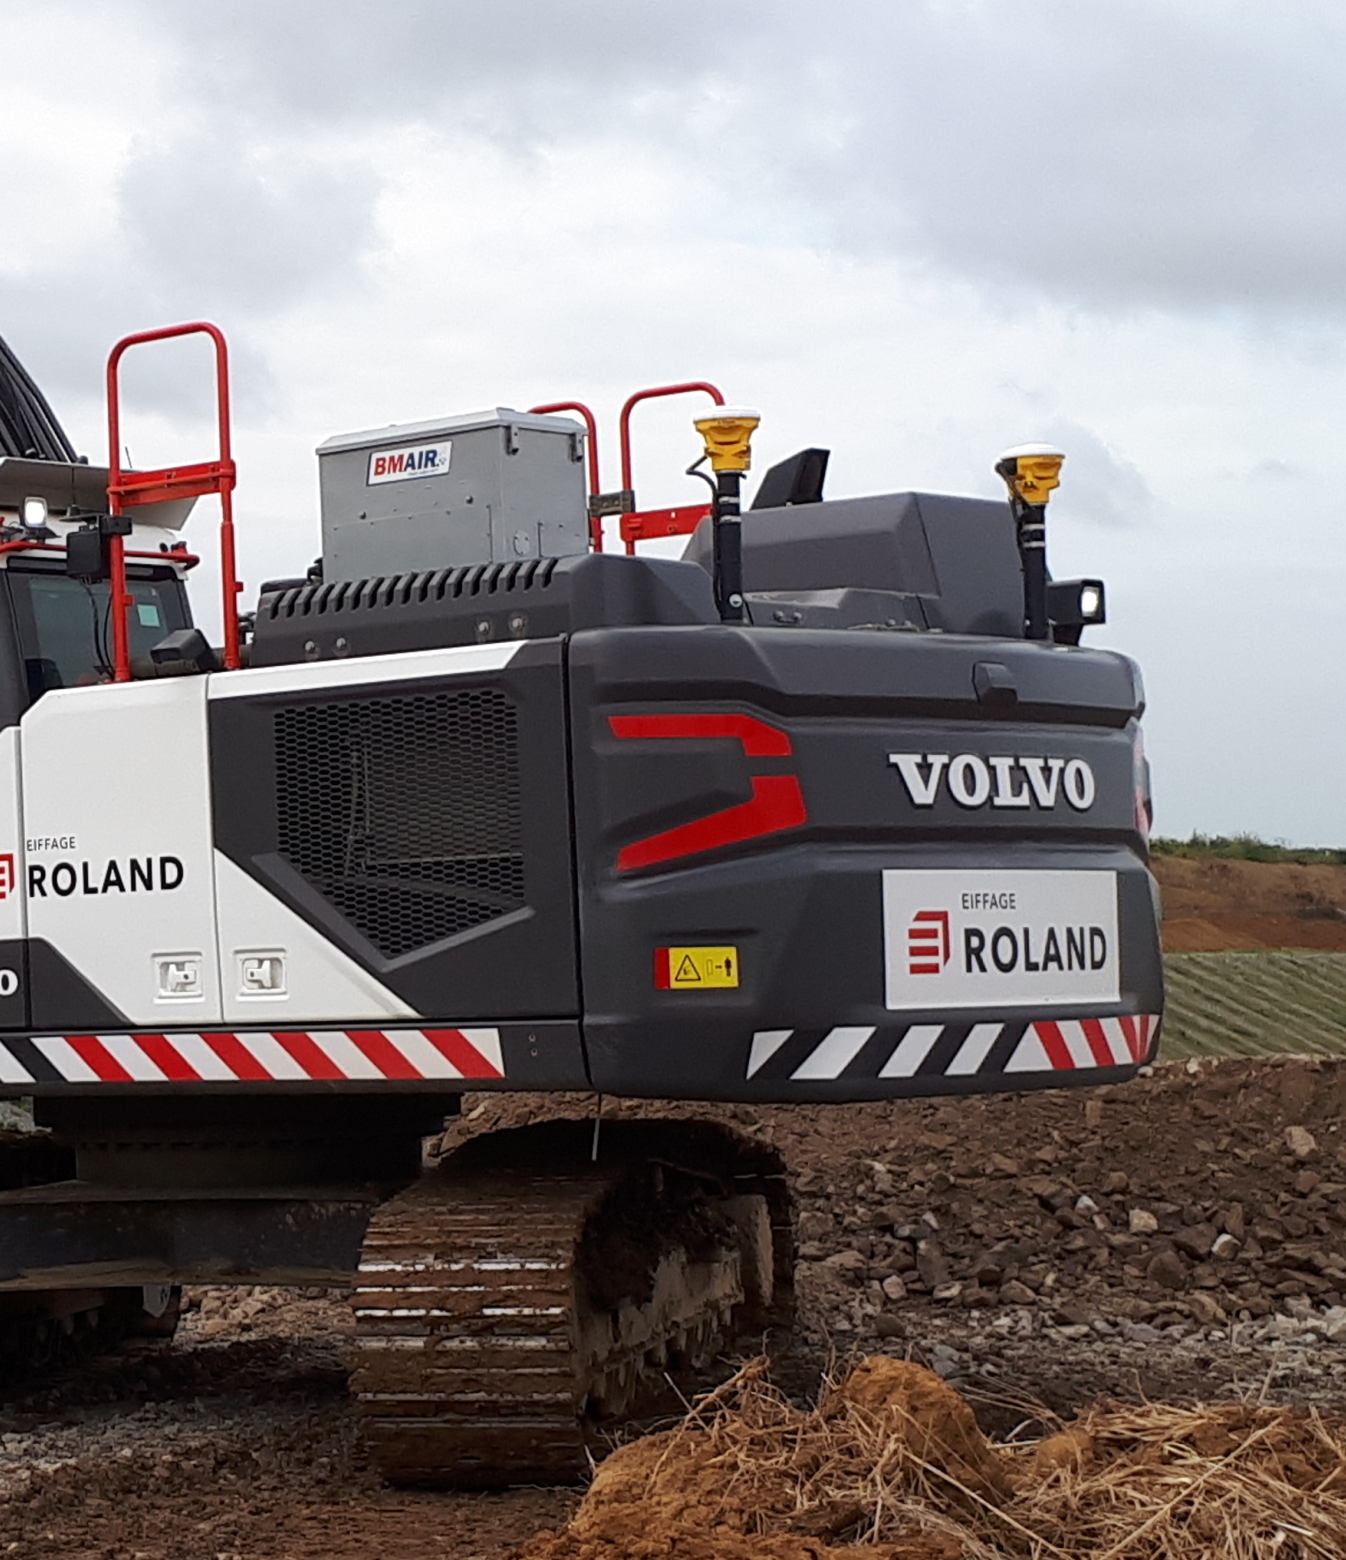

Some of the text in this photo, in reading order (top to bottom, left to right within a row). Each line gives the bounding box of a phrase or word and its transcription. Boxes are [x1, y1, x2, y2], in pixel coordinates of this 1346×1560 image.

[889, 753, 1095, 809] VOLVO
[26, 836, 76, 851] EIFFAGE
[28, 856, 184, 897] ROLAND
[961, 893, 1016, 909] EIFFAGE
[964, 926, 1107, 973] ROLAND
